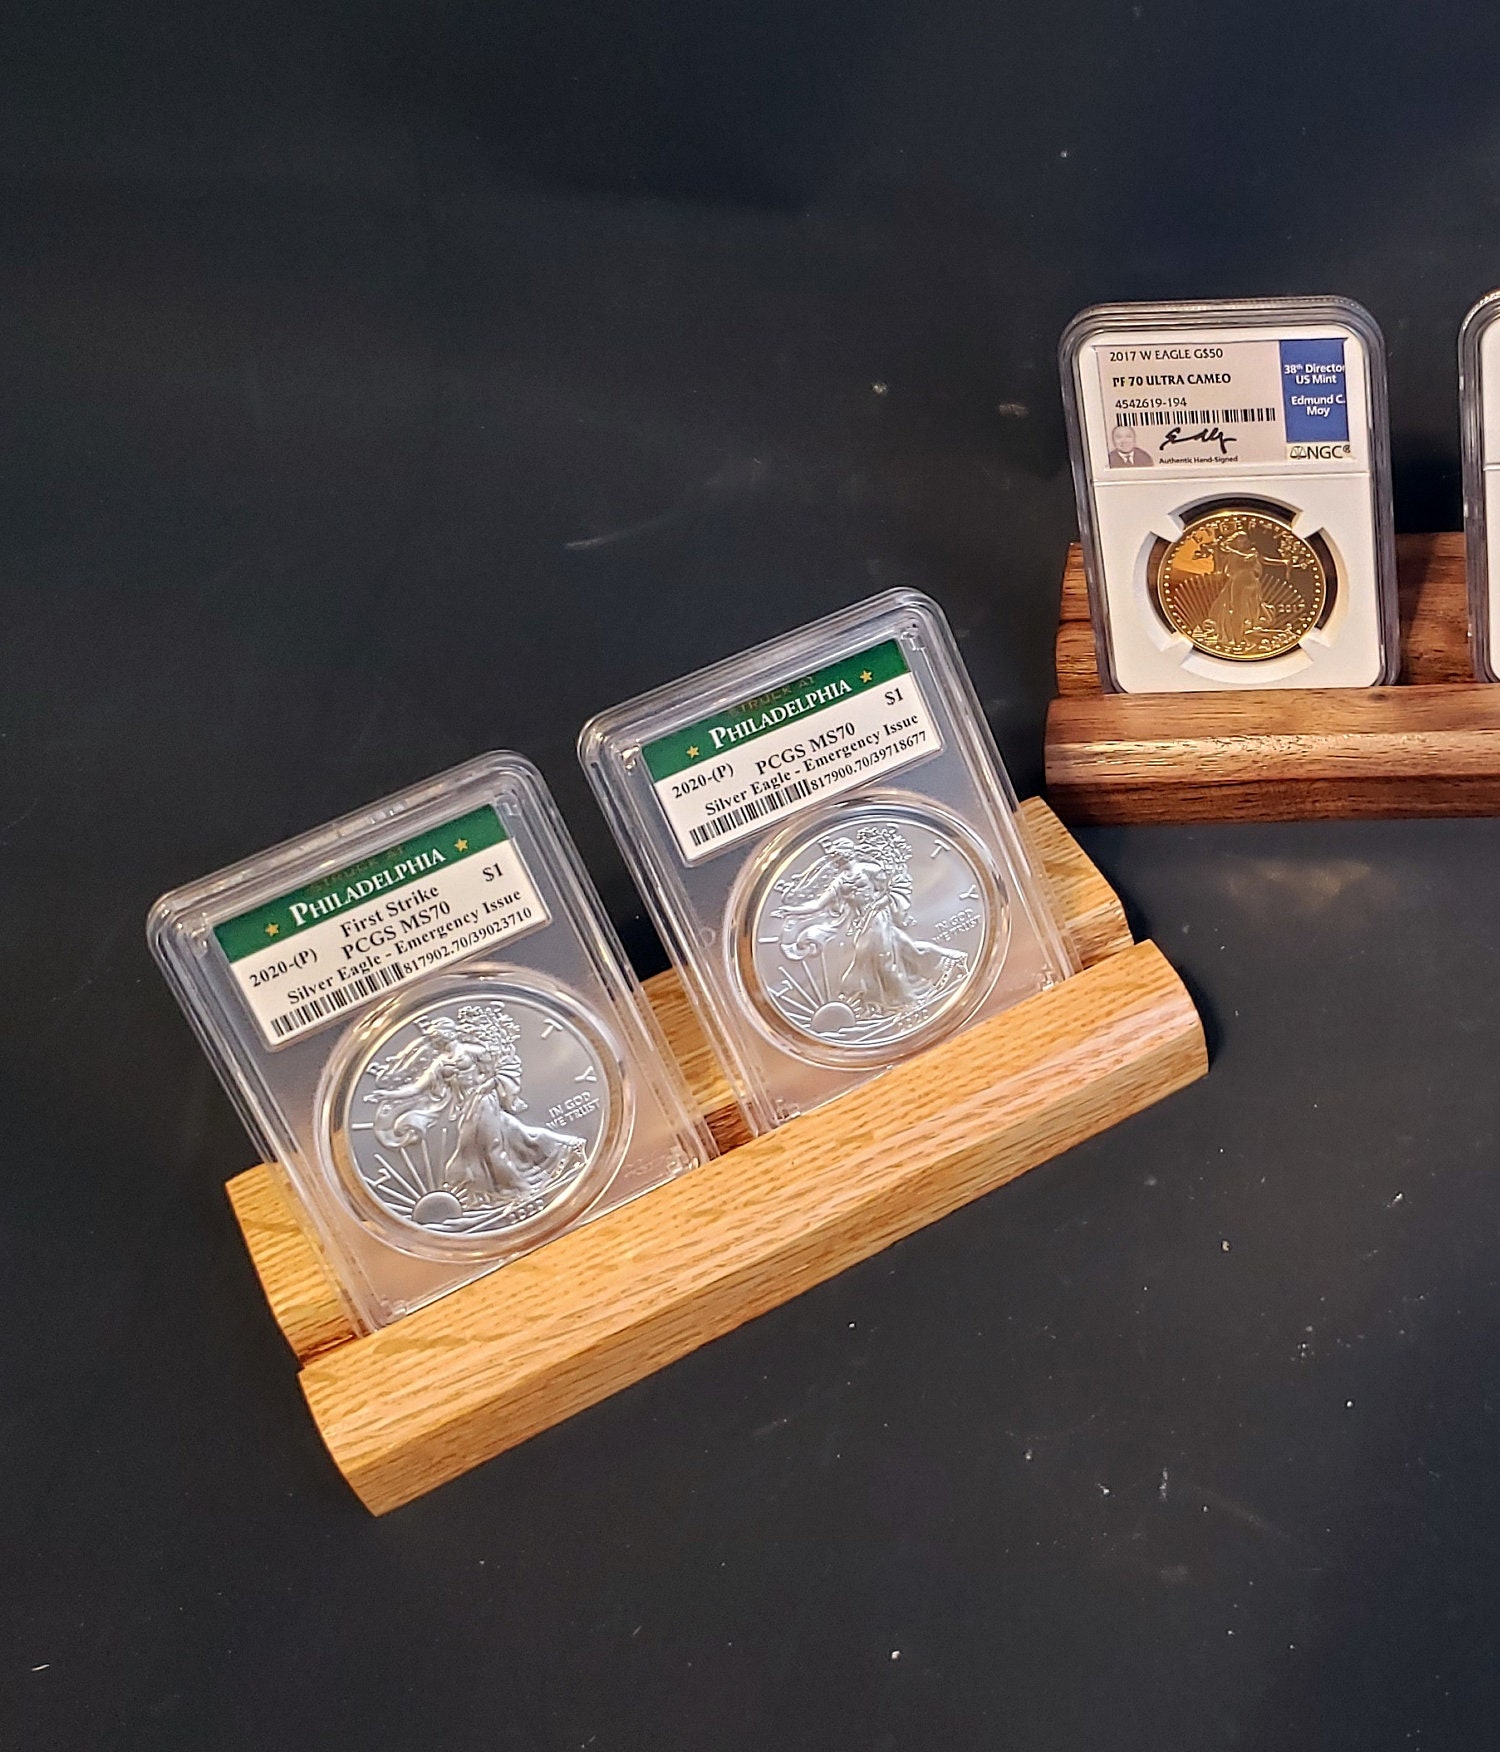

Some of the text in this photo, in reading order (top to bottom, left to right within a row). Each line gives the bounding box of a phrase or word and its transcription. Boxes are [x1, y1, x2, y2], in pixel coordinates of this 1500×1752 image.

[1110, 347, 1223, 363] 2017 W EAGLE G$50
[1113, 373, 1231, 388] PF 70 ULTRA CAMEO
[1295, 373, 1337, 385] US Mint
[1115, 397, 1187, 409] 4542619-194
[1291, 394, 1334, 406] Edmund
[1306, 405, 1330, 417] Moy
[1159, 456, 1192, 465] Authentic
[708, 679, 852, 750] PHILADELPHIA
[884, 687, 904, 707] $1
[704, 788, 748, 817] Silver
[750, 770, 792, 798] Eagle
[803, 731, 881, 772] Emergency
[883, 713, 919, 736] Issue
[755, 722, 856, 776] PCGS MS70
[810, 730, 927, 791] 817900.70/39718677
[671, 762, 735, 799] 2020-(P)
[288, 848, 447, 926] PHILADELPHIA
[482, 863, 504, 883] $1
[339, 886, 440, 938] First Strike
[341, 901, 451, 960] PCGS MS70
[287, 975, 333, 1005] Silver
[339, 953, 382, 982] Eagle
[396, 909, 479, 955] Emergency
[482, 889, 522, 914] Issue
[403, 907, 533, 975] 817902.70/39023710
[249, 947, 318, 988] 2020-(P)
